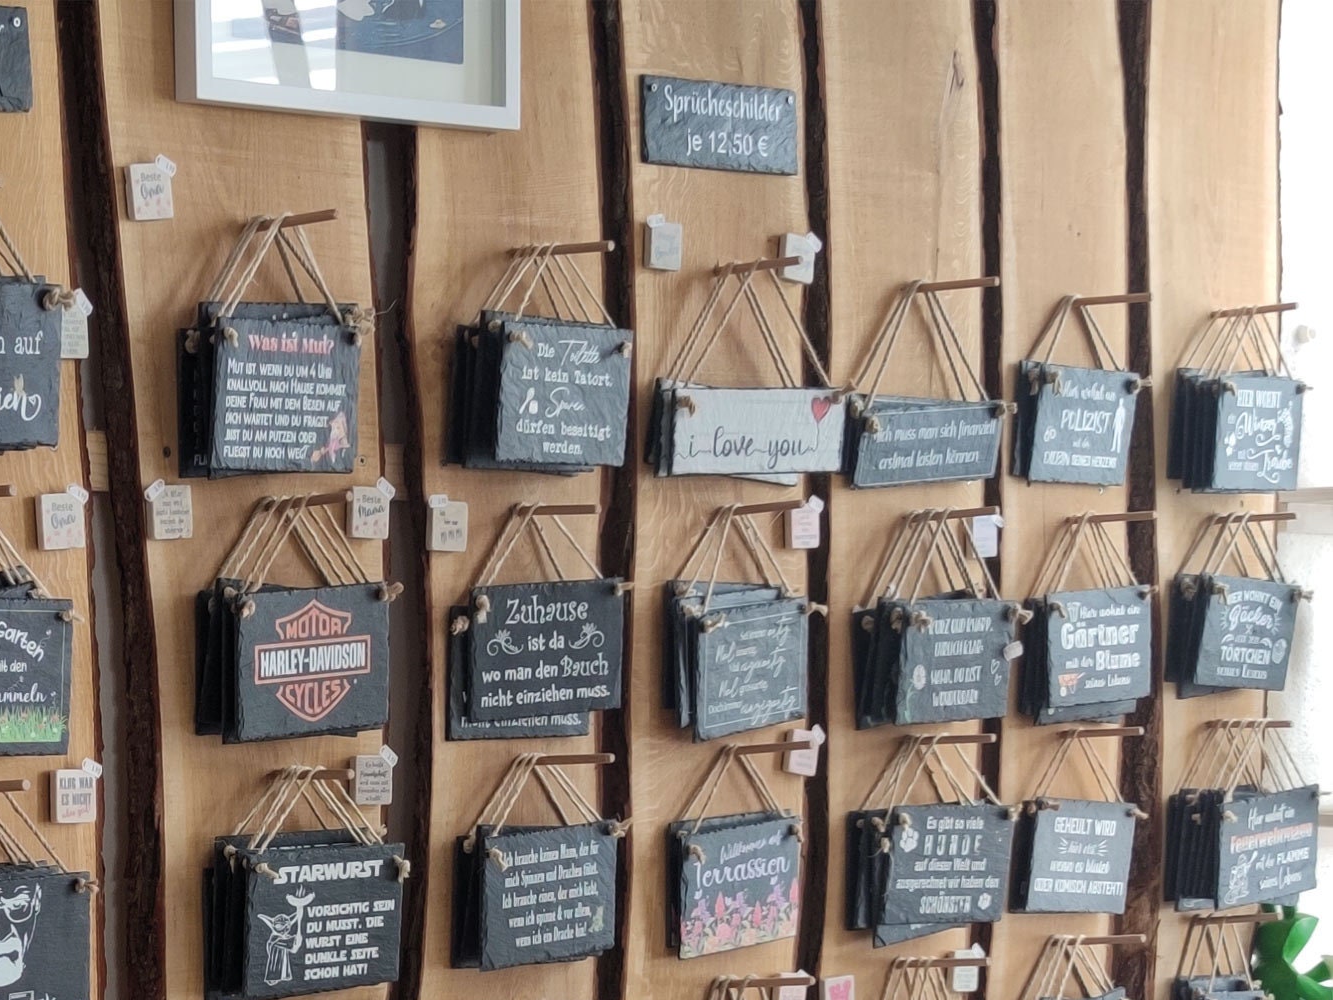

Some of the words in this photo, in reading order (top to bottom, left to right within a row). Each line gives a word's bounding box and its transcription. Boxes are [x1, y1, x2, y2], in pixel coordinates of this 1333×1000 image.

[664, 84, 783, 122] Sprücheschilder
[686, 128, 703, 156] je
[709, 131, 753, 157] 12,50
[757, 135, 769, 157] €
[14, 330, 44, 355] auf
[713, 425, 756, 457] love
[767, 438, 805, 469] you
[286, 608, 342, 639] MOTOR
[505, 594, 589, 625] Zuhause
[527, 635, 546, 651] ist
[548, 630, 565, 650] da
[1061, 622, 1139, 650] Gärtner
[260, 641, 366, 677] HARLEY-DAVIDSON
[482, 670, 501, 684] wo
[505, 666, 532, 681] man
[535, 660, 558, 679] den
[560, 652, 609, 677] Bauch
[1096, 650, 1140, 671] Blume
[285, 679, 342, 714] CYCLES
[481, 688, 513, 708] nicht
[516, 683, 574, 705] einziehen
[576, 685, 610, 698] muss.
[273, 859, 384, 885] STARWURST
[693, 856, 791, 890] Terrassien
[307, 902, 369, 918] VORSICHTIG
[373, 899, 395, 912] SEIN
[304, 949, 347, 965] DUNKLE
[350, 946, 379, 960] SEITE
